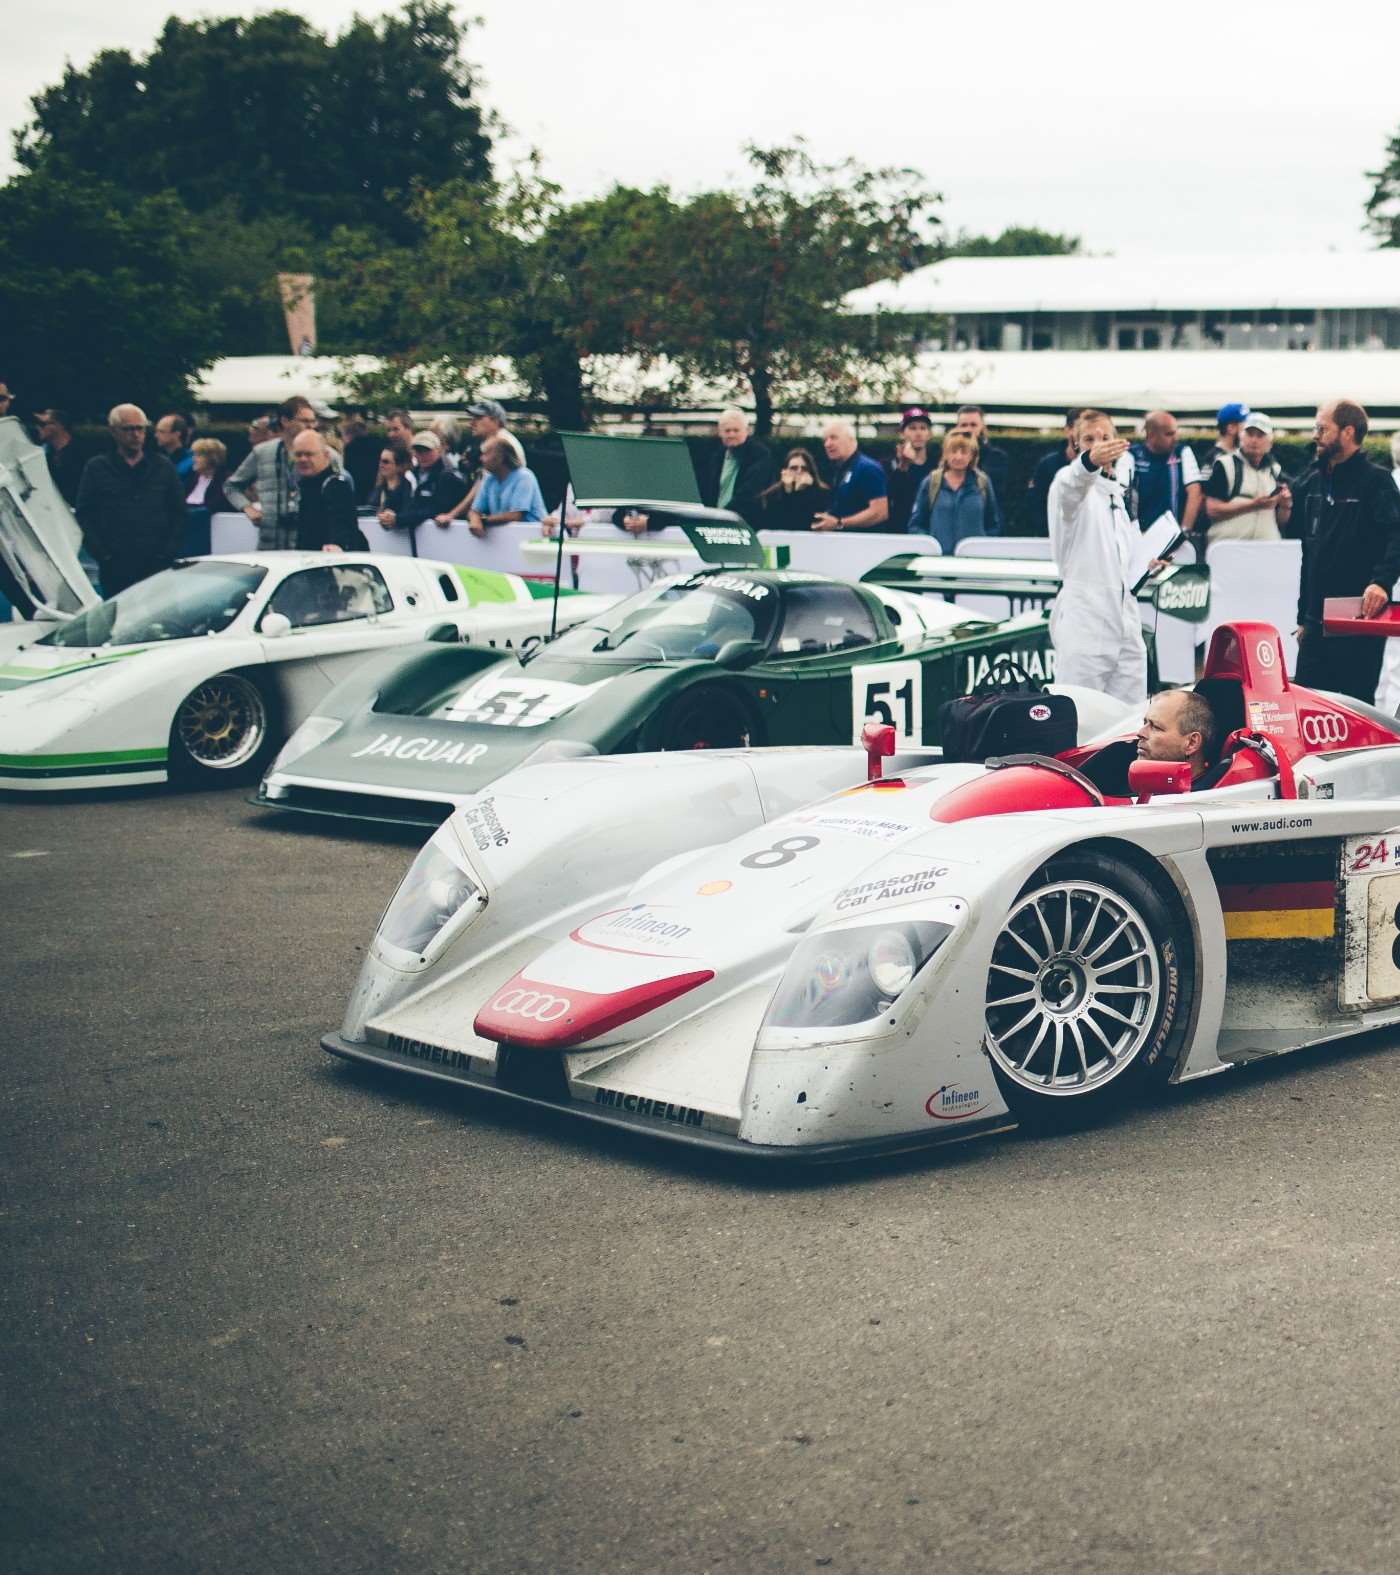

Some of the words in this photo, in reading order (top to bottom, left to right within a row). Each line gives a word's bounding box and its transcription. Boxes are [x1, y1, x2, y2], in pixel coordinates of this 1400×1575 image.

[1158, 580, 1209, 609] Castrol
[463, 691, 549, 727] 51
[864, 677, 915, 738] 51
[351, 733, 489, 765] JAGUAR
[1231, 817, 1313, 833] www.audi.com
[740, 836, 820, 869] 8
[1352, 839, 1389, 871] 24
[833, 866, 949, 903] Panasonic
[836, 894, 875, 911] Car
[875, 880, 937, 901] Audio
[1072, 991, 1094, 1021] RACING
[1147, 966, 1178, 1065] MICHELIN
[386, 1033, 472, 1071] MICHELIN
[595, 1086, 705, 1126] MICHELIN
[942, 1090, 980, 1106] Infineon
